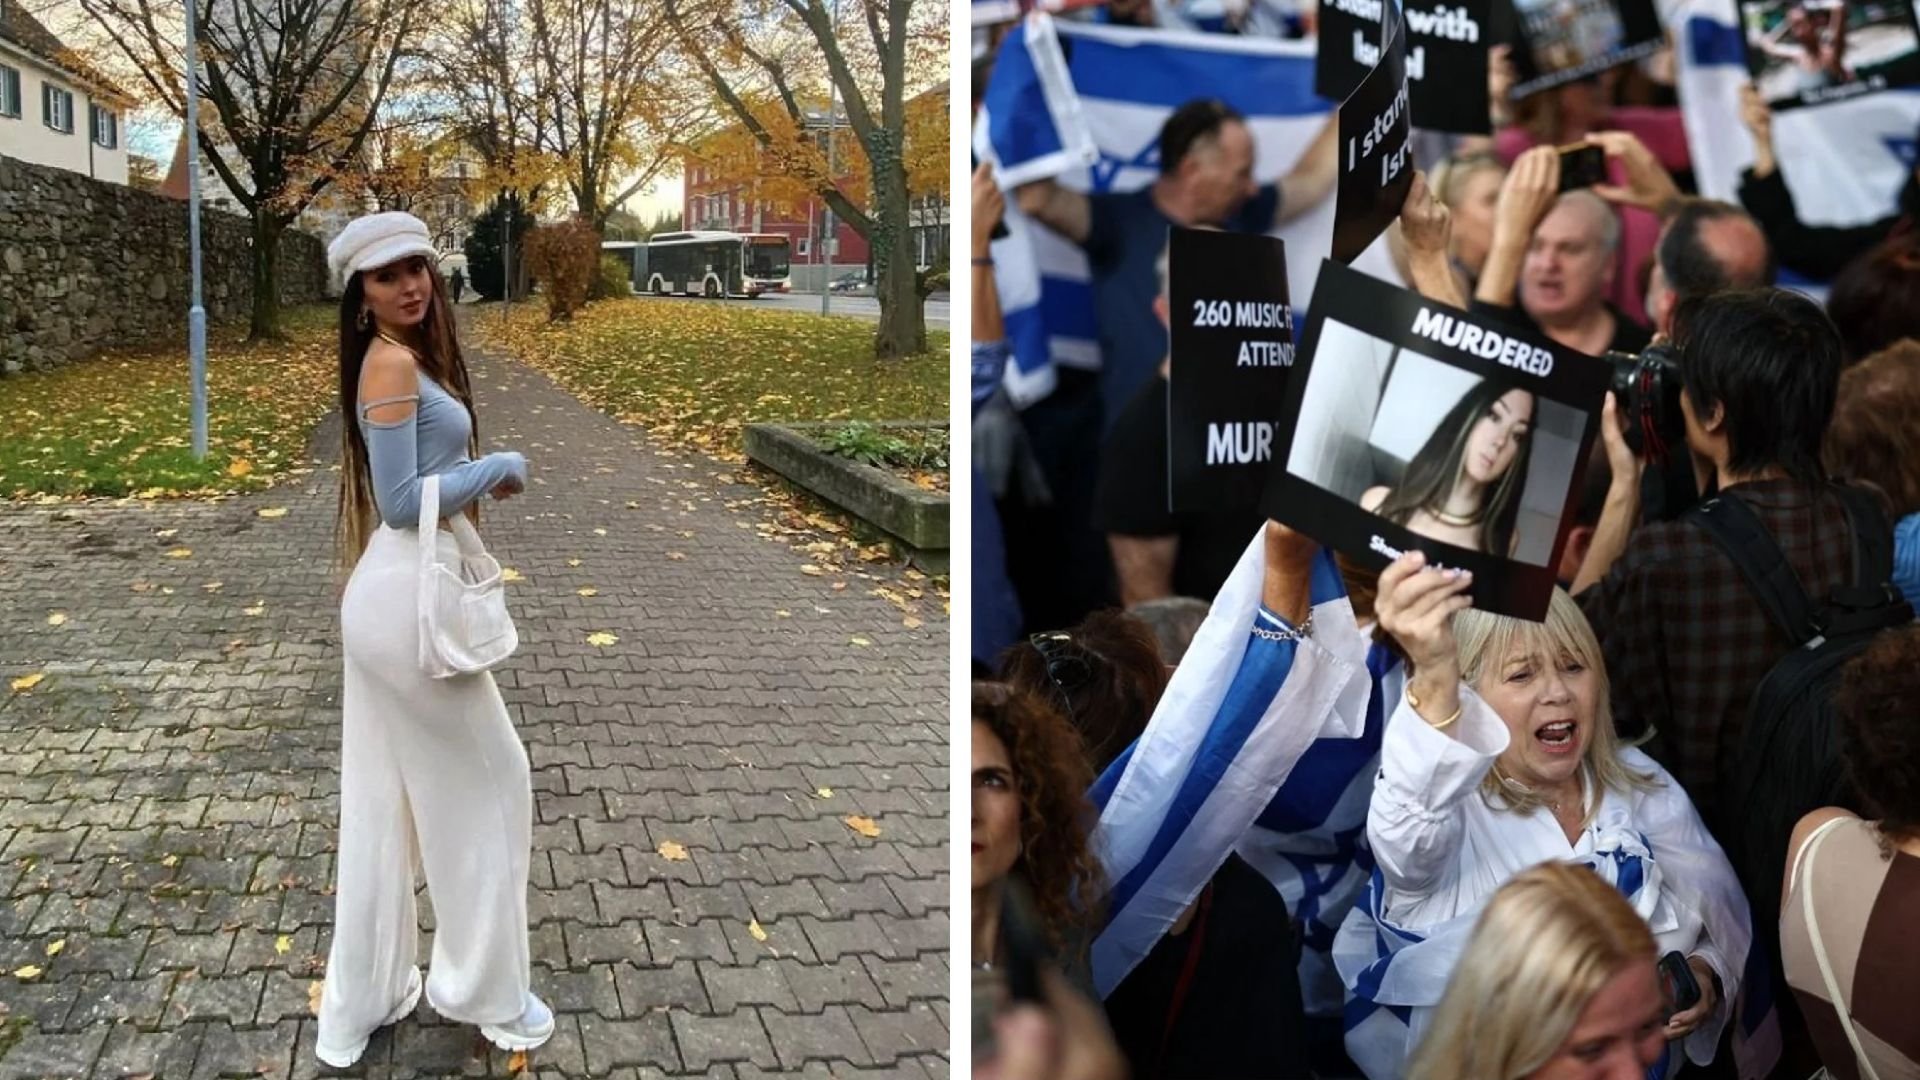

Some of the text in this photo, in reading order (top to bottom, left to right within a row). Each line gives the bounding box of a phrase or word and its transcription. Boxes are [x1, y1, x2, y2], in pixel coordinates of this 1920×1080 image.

[1405, 4, 1479, 43] with
[1348, 136, 1356, 172] I
[1193, 299, 1232, 327] 260
[1235, 301, 1284, 329] MUSIC
[1237, 341, 1295, 367] ATTEND
[1411, 307, 1554, 377] MURDERED
[1206, 421, 1279, 465] MUR
